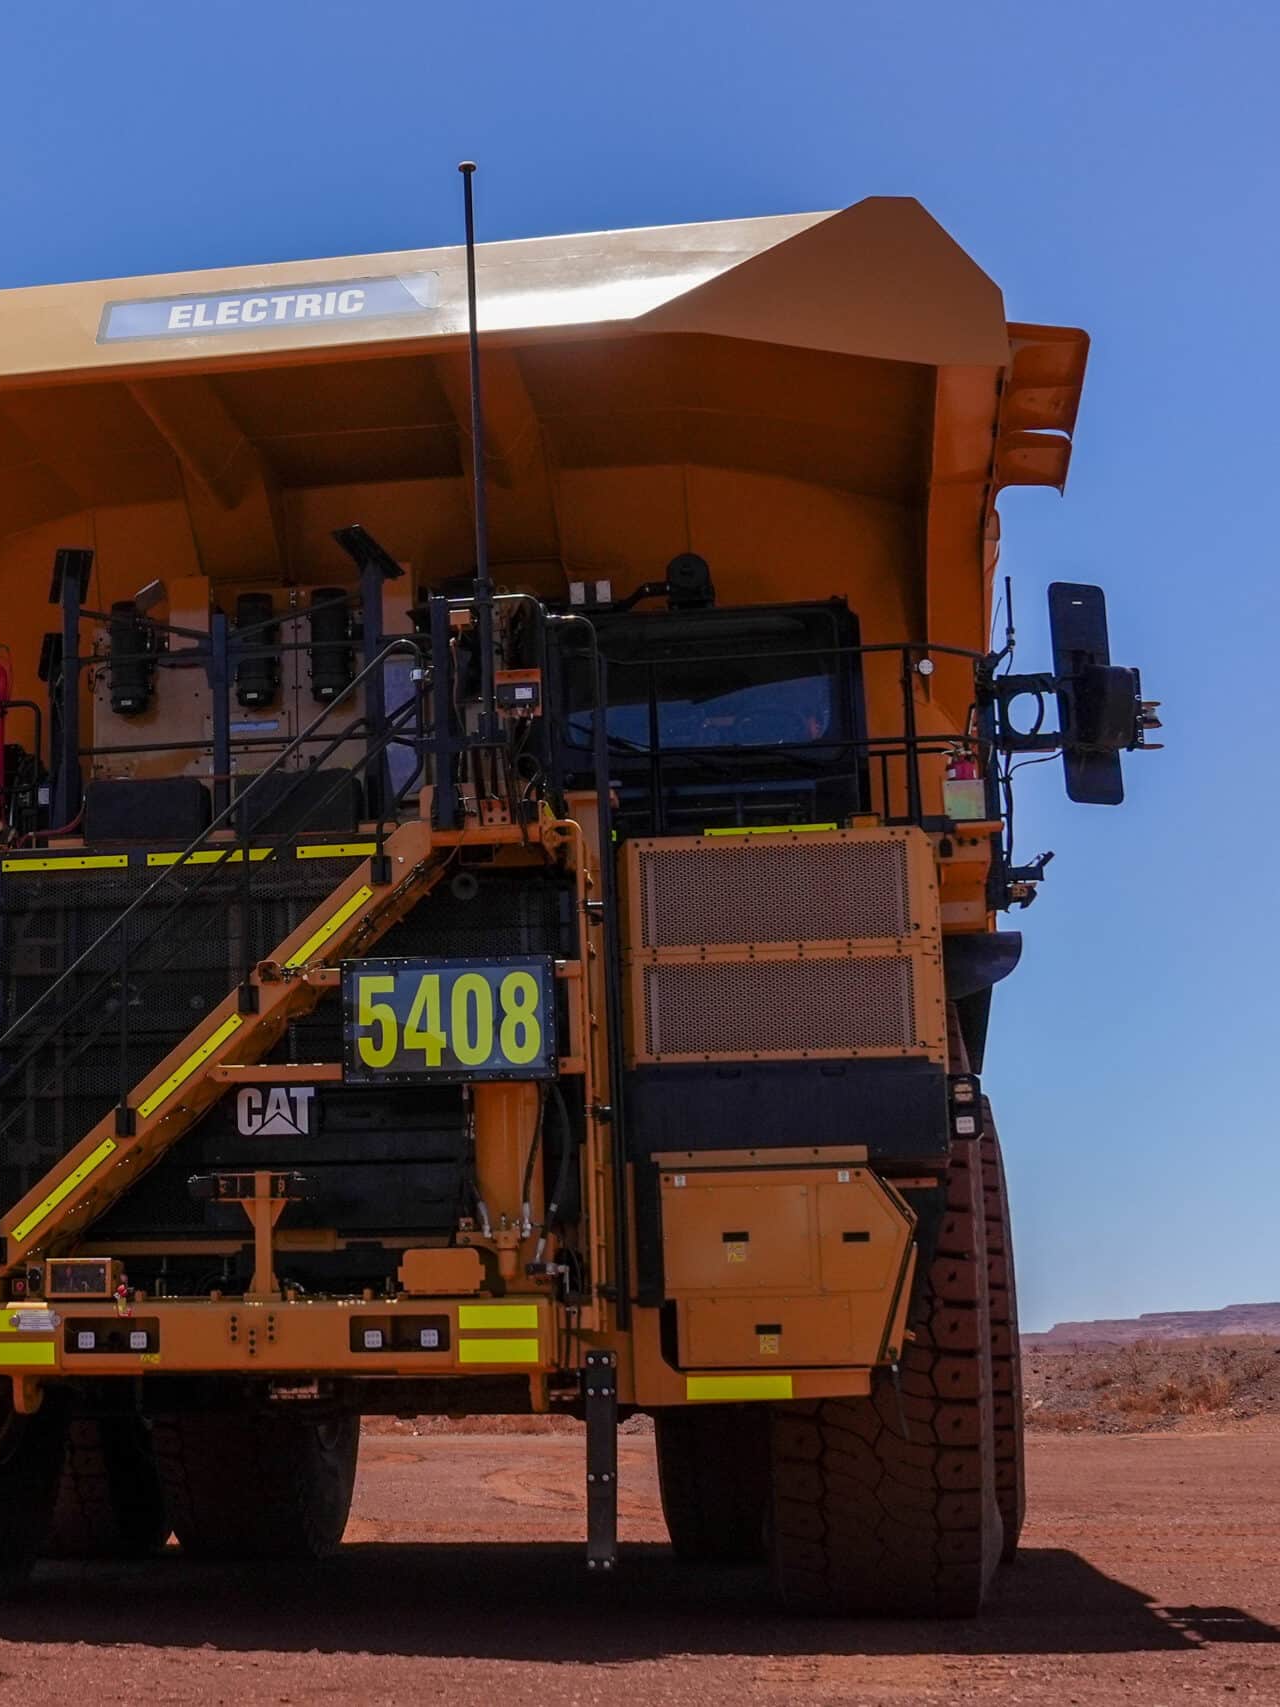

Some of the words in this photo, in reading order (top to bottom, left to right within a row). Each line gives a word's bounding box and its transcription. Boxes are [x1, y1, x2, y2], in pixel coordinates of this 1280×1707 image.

[167, 289, 366, 329] ELECTRIC
[357, 971, 541, 1068] 5408
[237, 1086, 315, 1136] CAT
